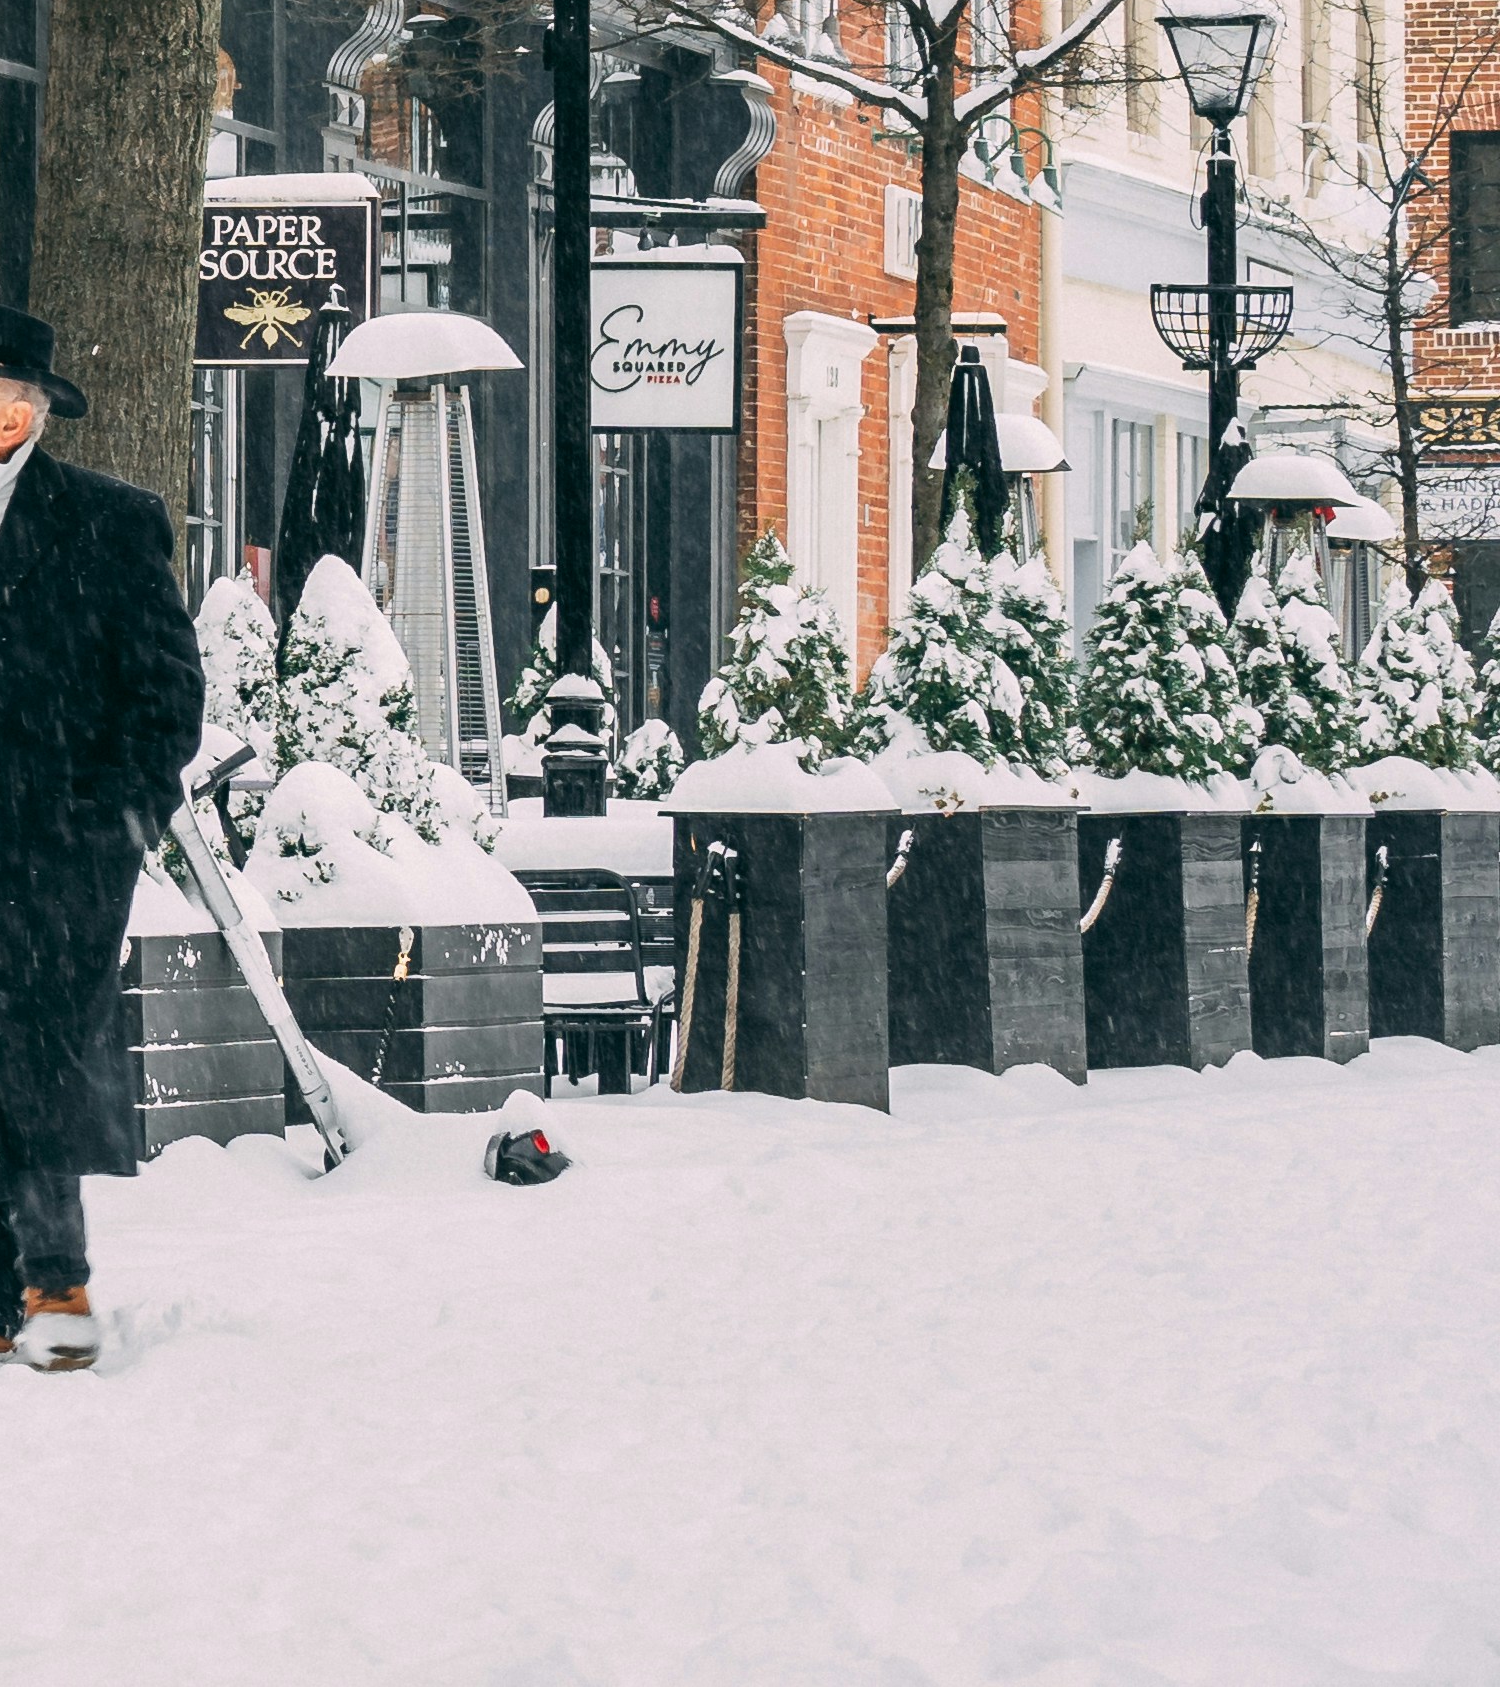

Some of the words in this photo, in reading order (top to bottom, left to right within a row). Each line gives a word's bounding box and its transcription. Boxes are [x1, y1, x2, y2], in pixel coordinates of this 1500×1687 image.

[210, 214, 326, 247] PAPER
[199, 247, 338, 281] SOURCE
[590, 303, 725, 394] Emmy
[612, 361, 687, 373] SQUARED
[647, 375, 681, 384] PIZZA
